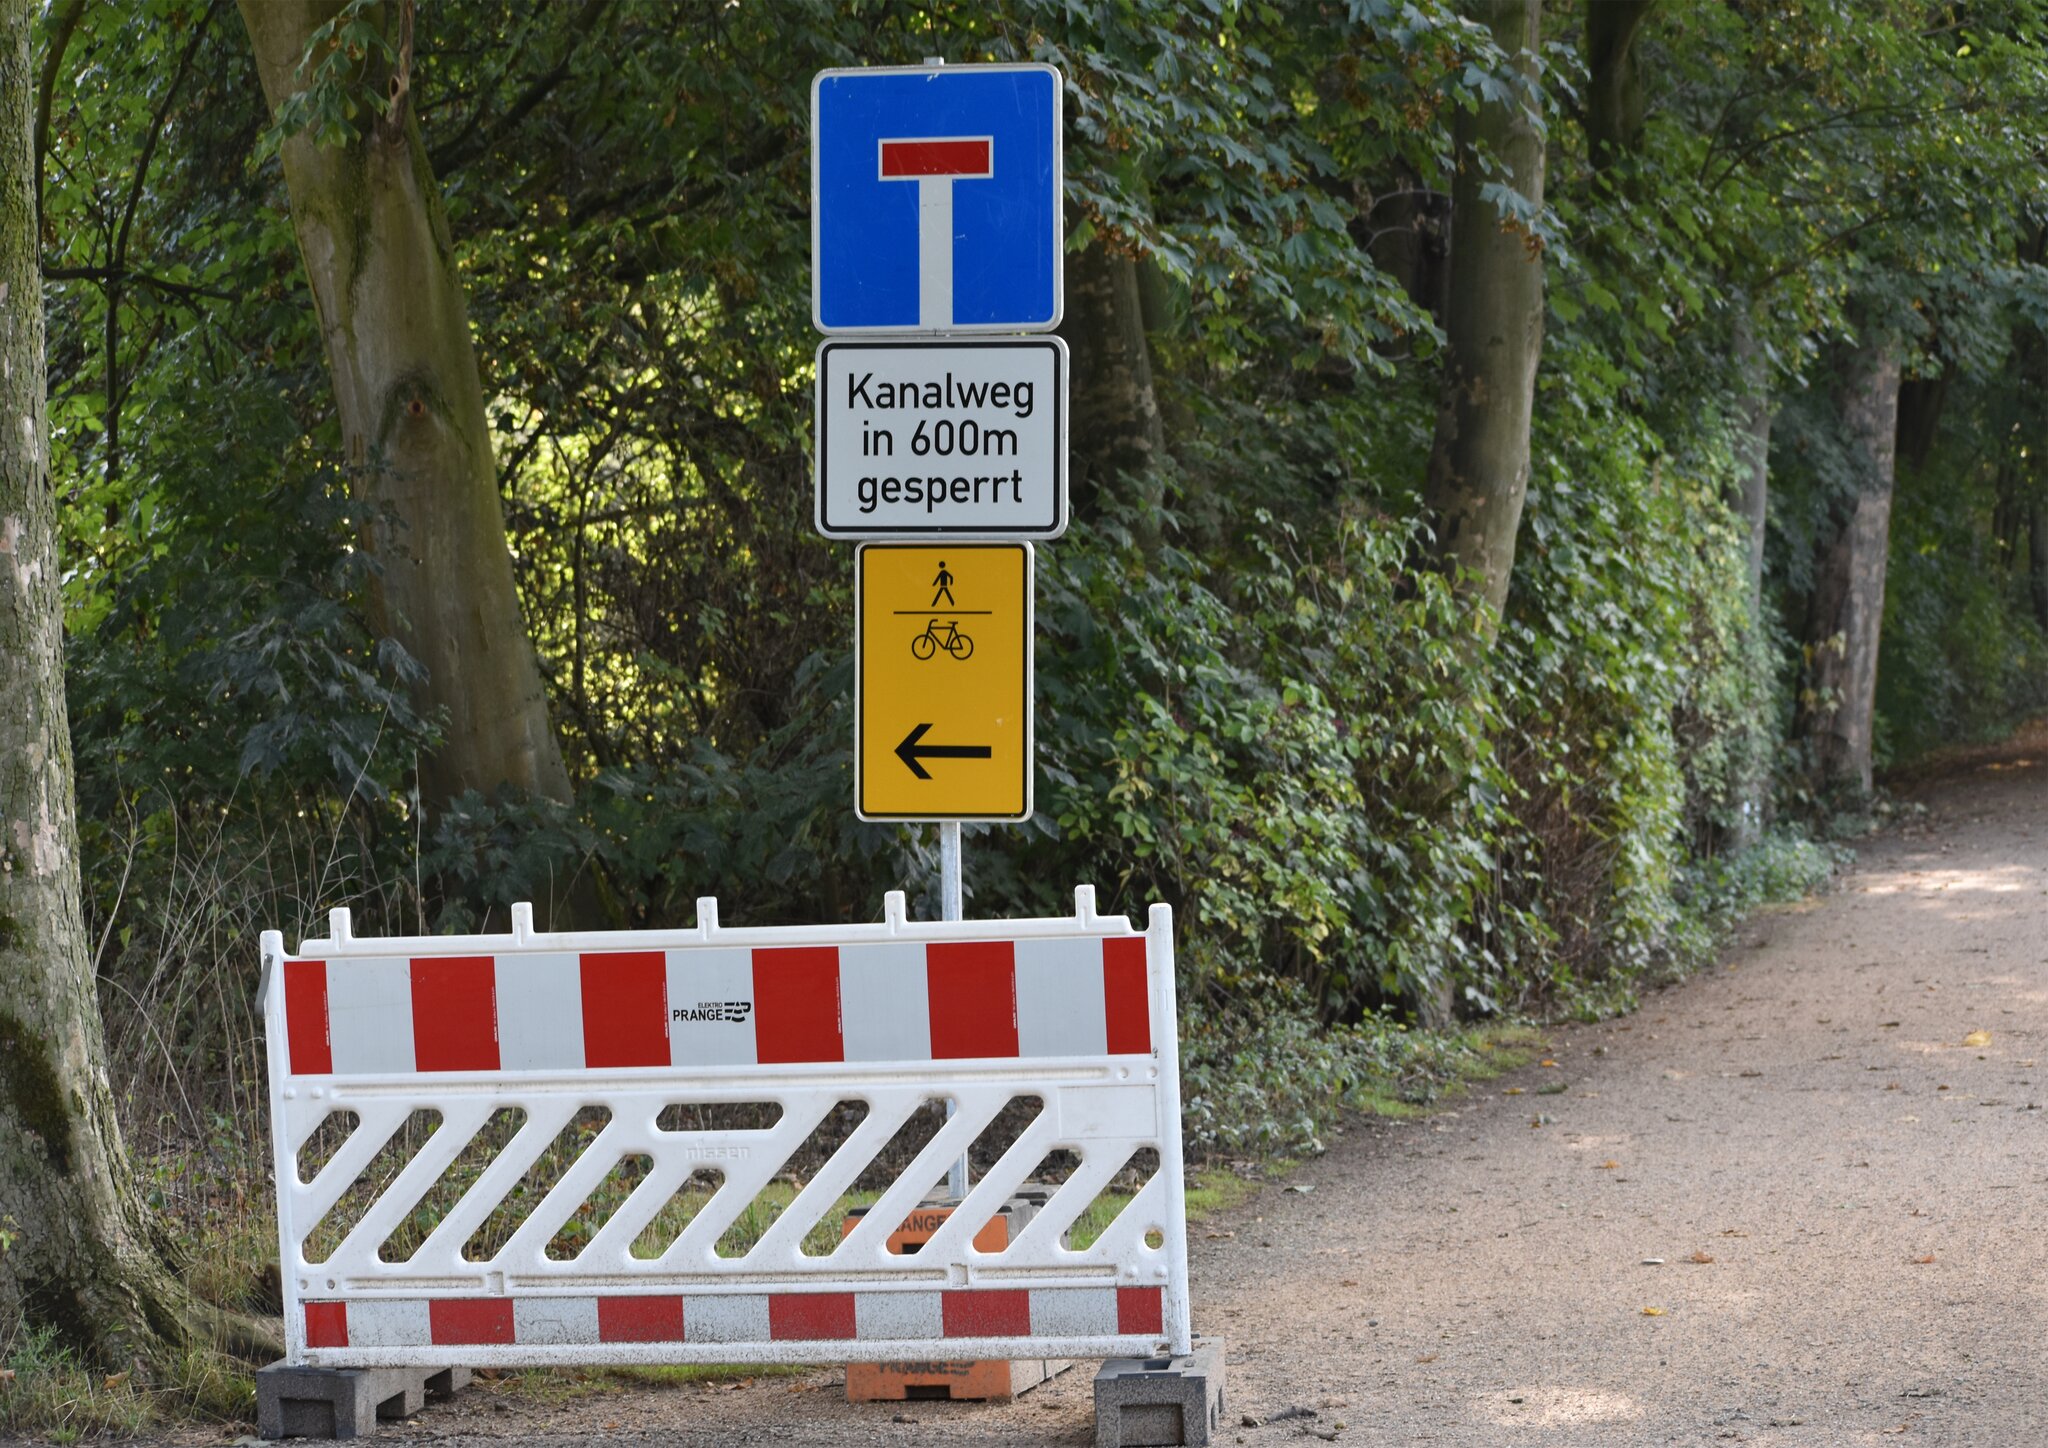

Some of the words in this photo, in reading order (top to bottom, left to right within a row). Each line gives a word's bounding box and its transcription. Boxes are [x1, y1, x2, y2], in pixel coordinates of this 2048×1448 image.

[848, 372, 1034, 418] Kanalweg
[863, 420, 893, 456] in
[911, 419, 1018, 456] 600m
[857, 469, 1022, 513] gesperrt
[673, 1009, 723, 1021] PRANGE
[896, 1215, 948, 1232] ANGE
